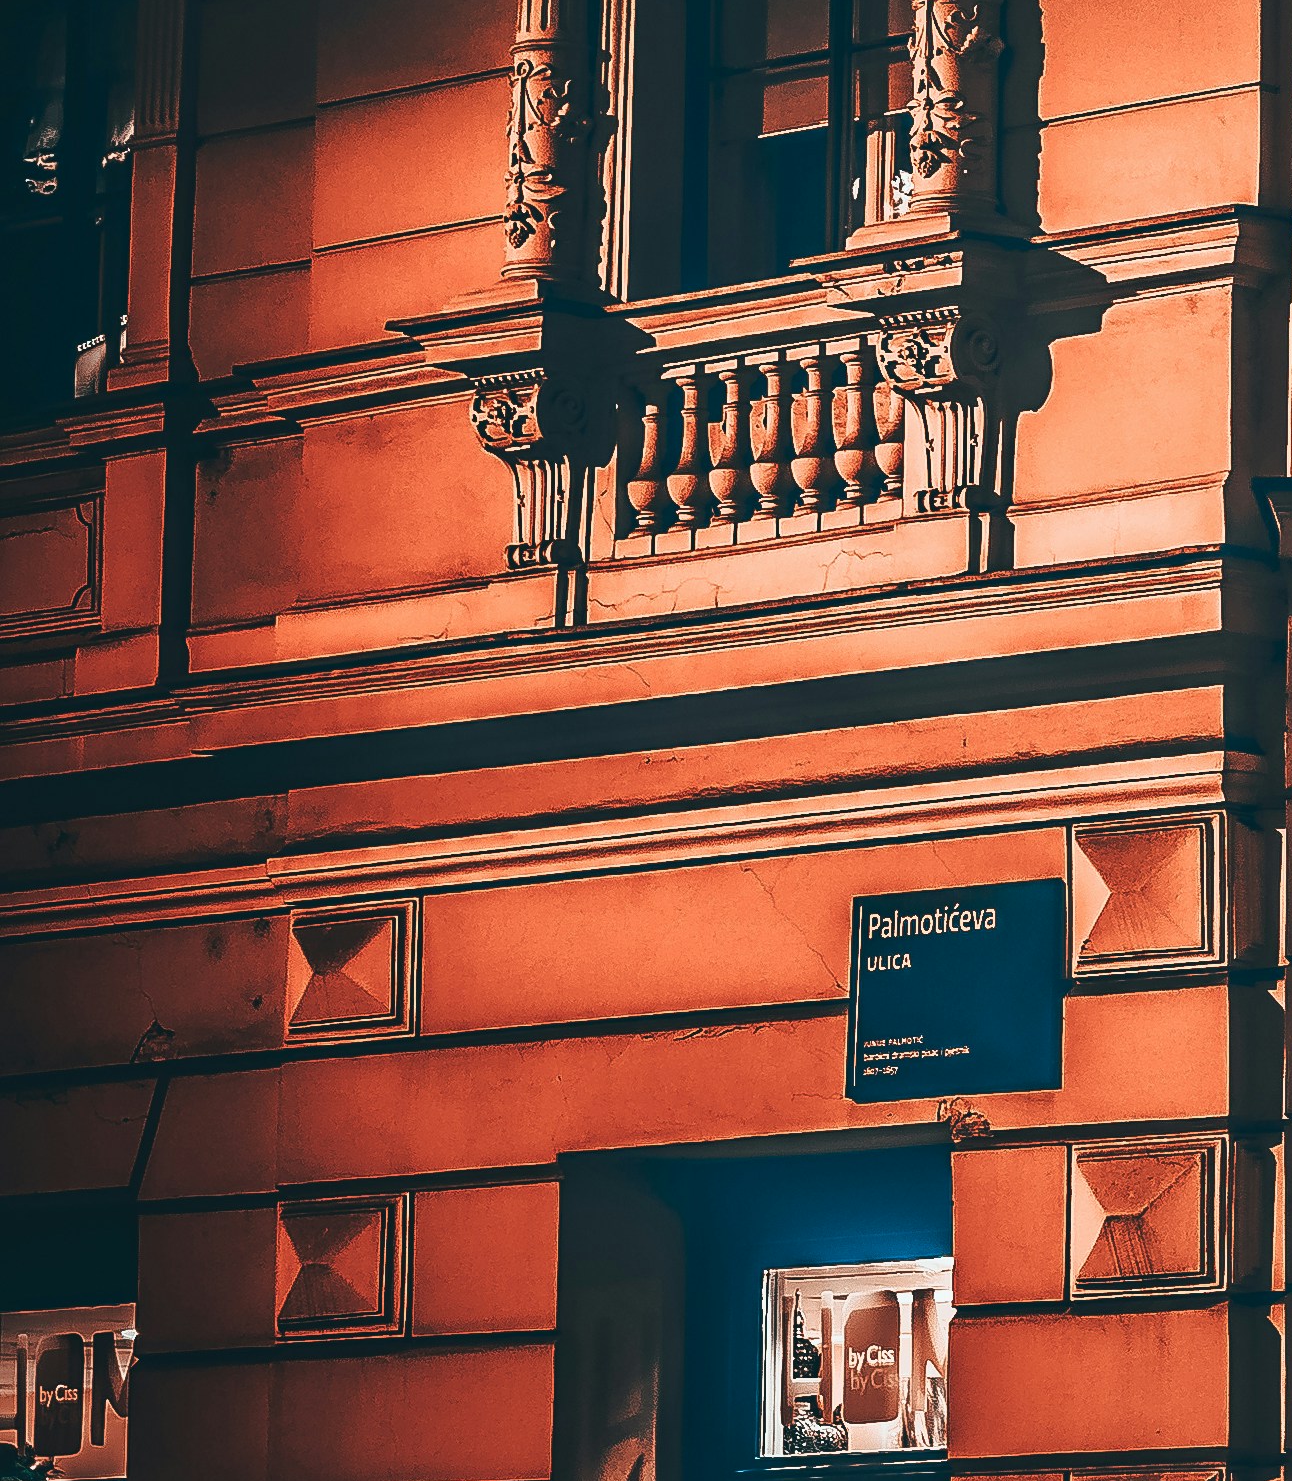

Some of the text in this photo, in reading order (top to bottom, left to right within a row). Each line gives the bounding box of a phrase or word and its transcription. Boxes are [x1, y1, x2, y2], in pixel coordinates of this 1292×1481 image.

[868, 902, 997, 939] Palmotićeva
[867, 953, 912, 971] ULICA
[849, 1344, 896, 1374] by Ciss
[40, 1384, 79, 1407] by Ciss
